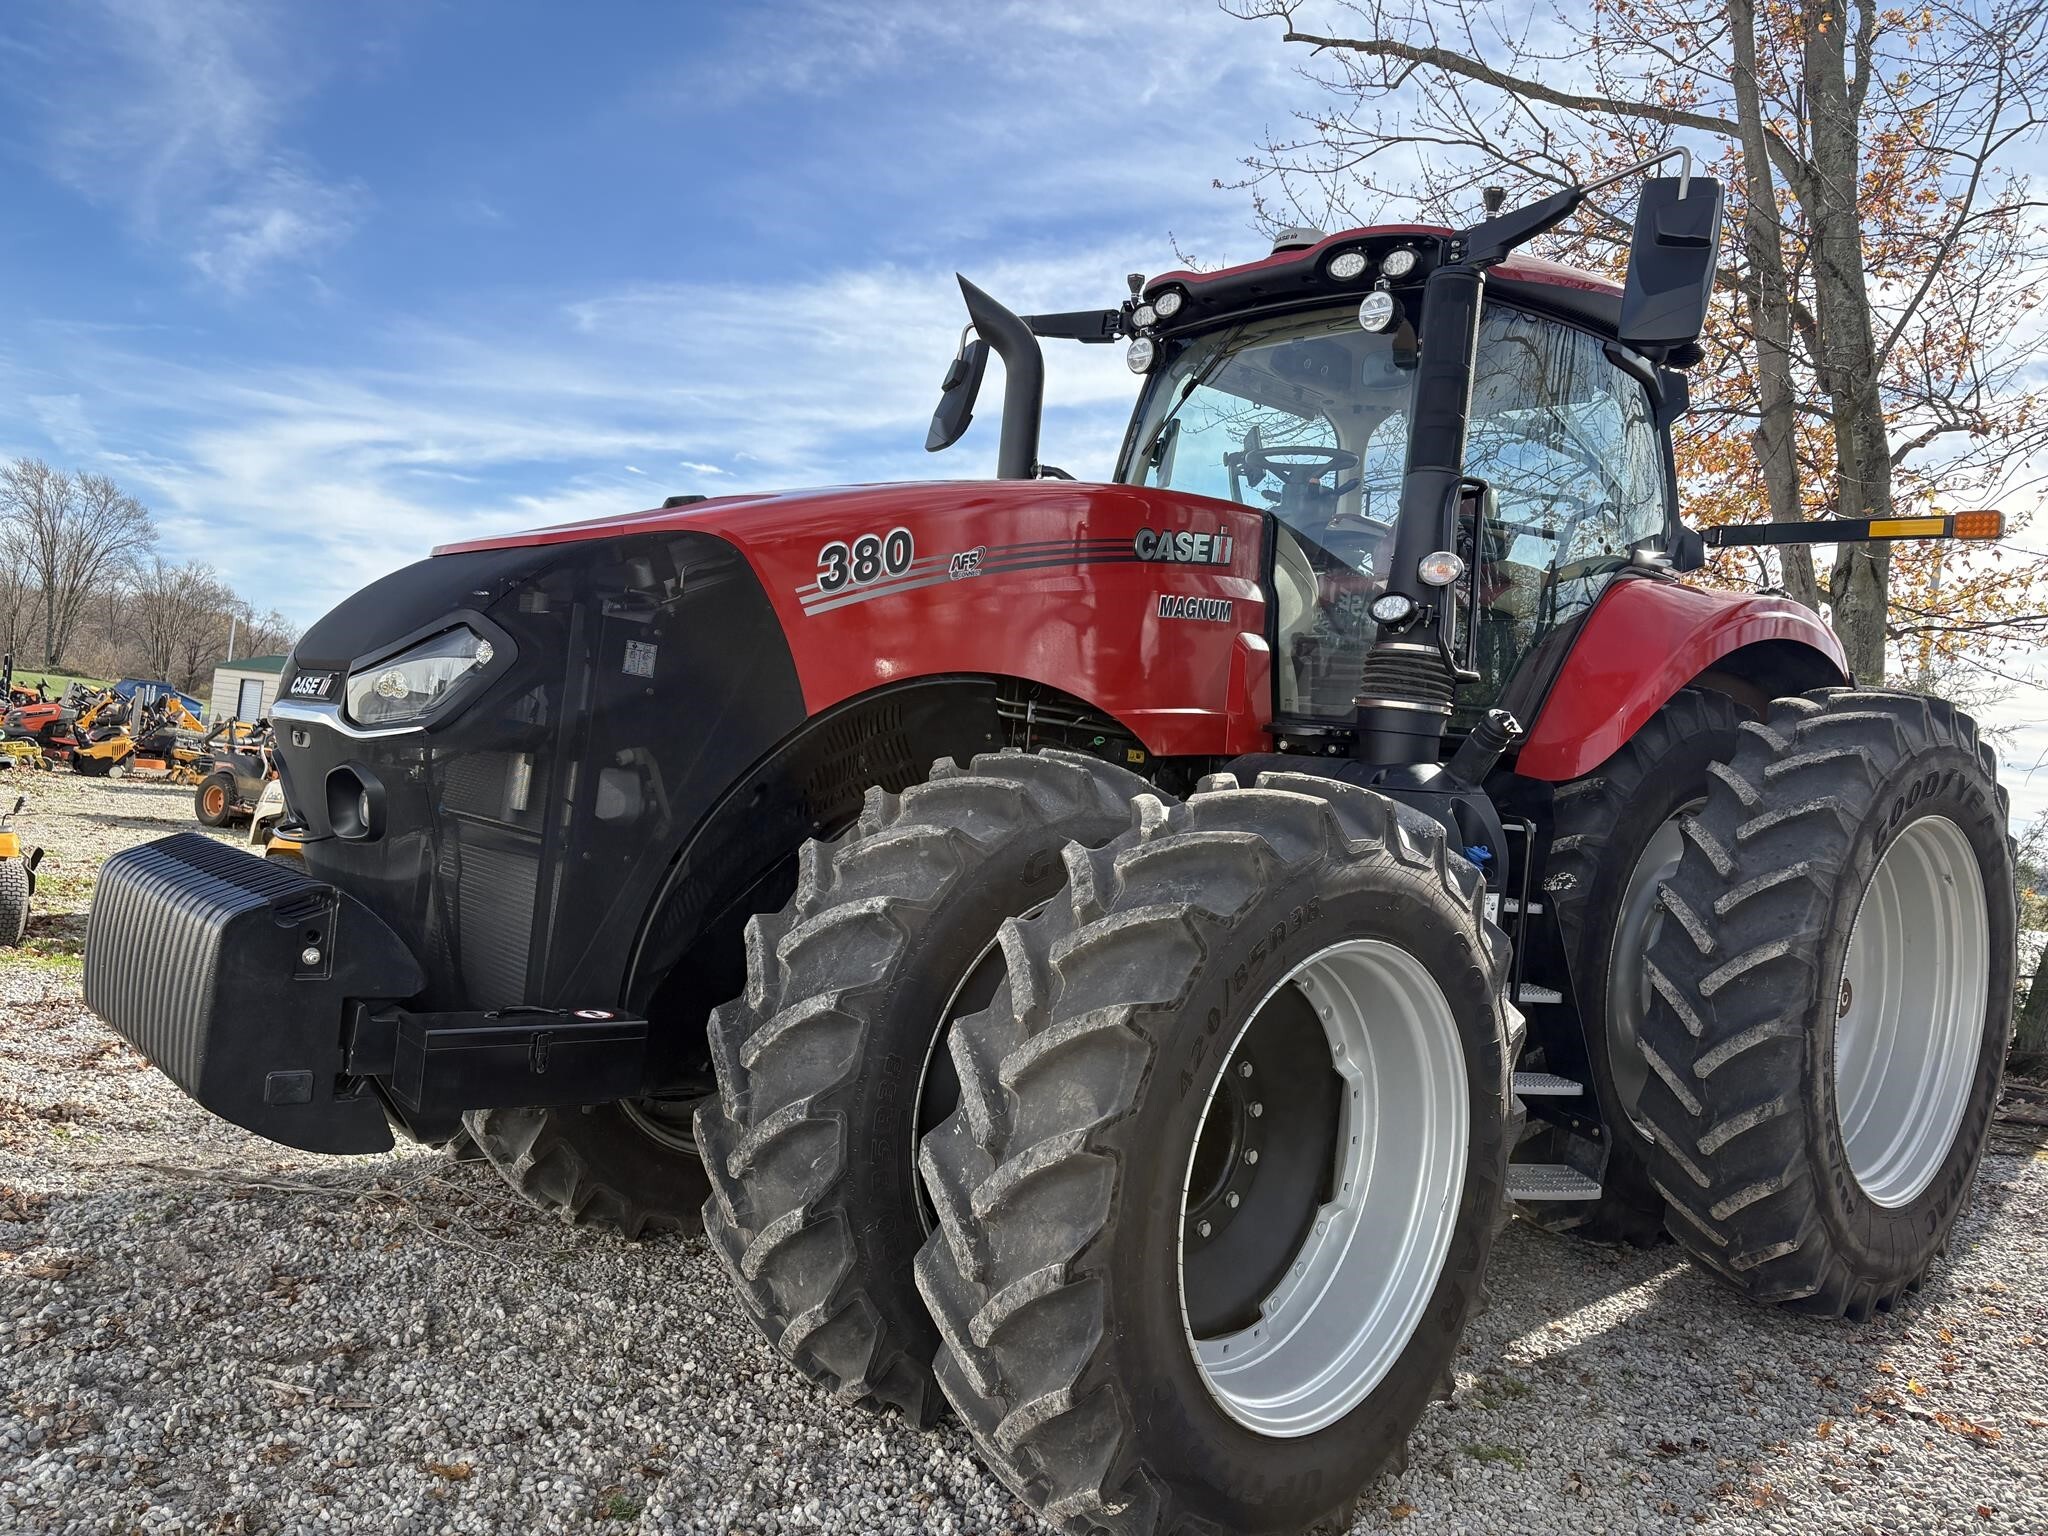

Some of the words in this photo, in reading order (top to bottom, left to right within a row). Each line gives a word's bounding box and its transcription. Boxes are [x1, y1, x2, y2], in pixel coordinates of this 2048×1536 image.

[1133, 528, 1212, 563] CASE
[815, 526, 915, 594] 380
[949, 551, 979, 571] AFS
[1157, 595, 1233, 622] MAGNUM
[290, 676, 320, 695] CASE
